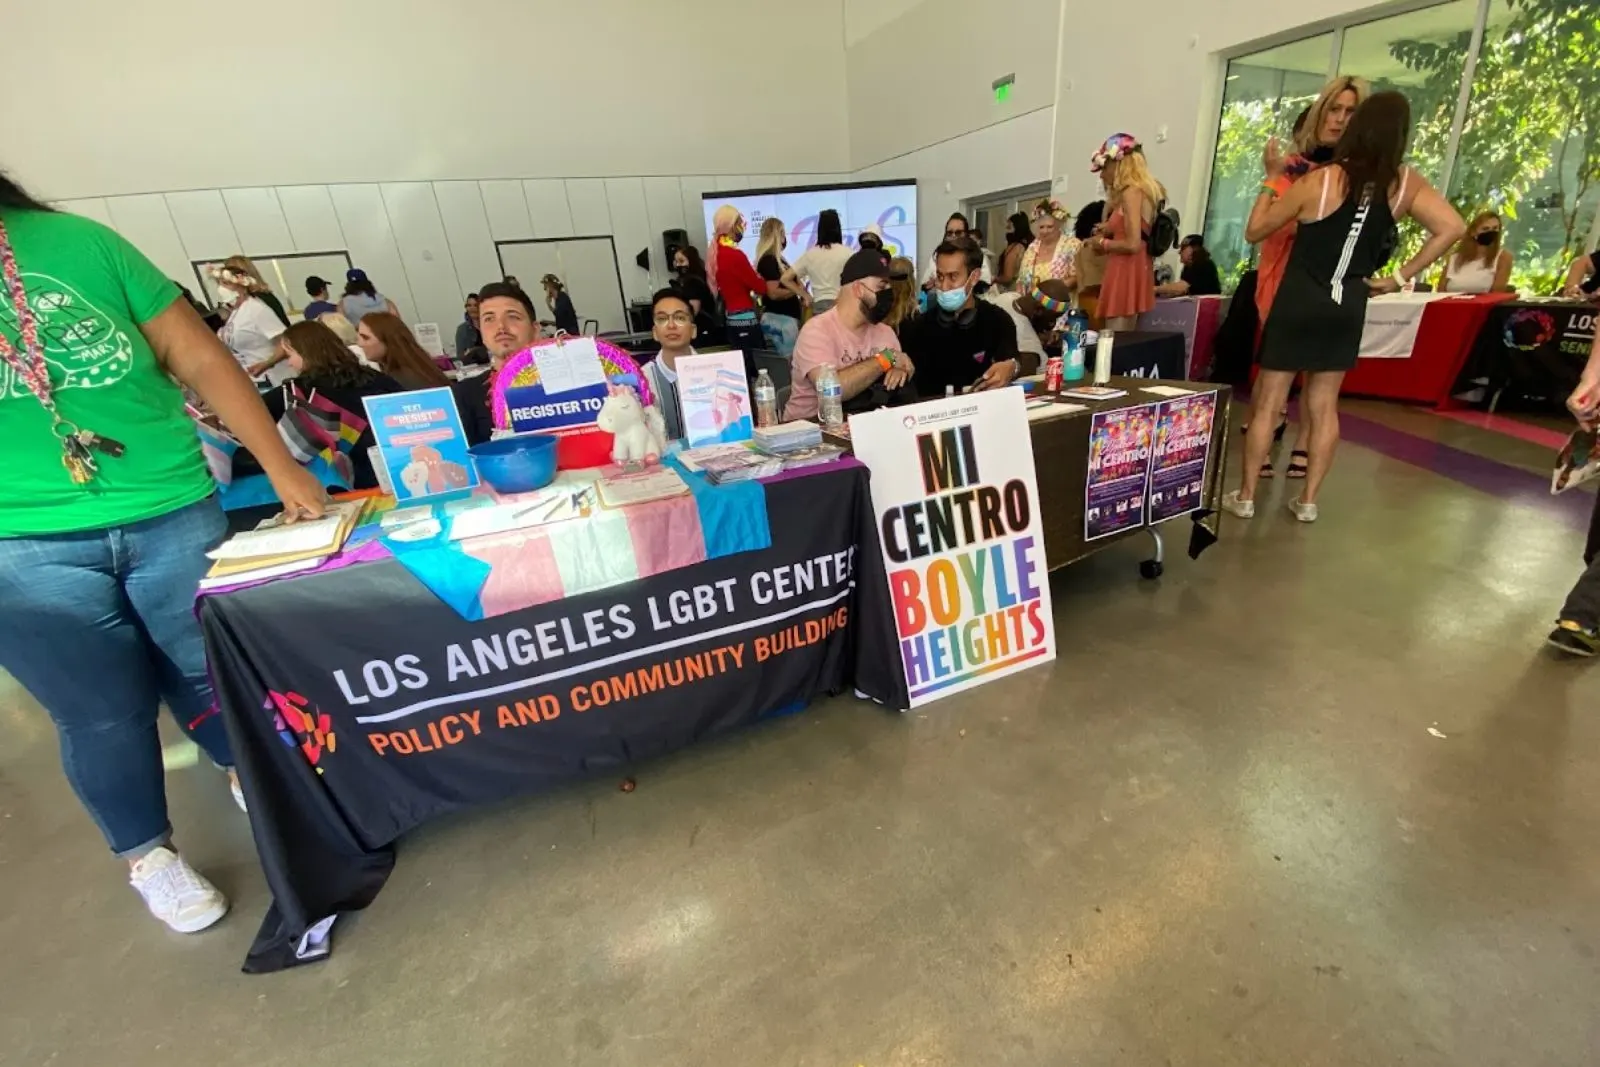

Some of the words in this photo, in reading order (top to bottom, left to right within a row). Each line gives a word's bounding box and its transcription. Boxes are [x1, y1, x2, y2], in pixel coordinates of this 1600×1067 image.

[512, 401, 580, 421] REGISTER
[581, 398, 602, 412] TO
[928, 410, 948, 420] ANGELES
[960, 405, 979, 414] CENTER
[1166, 432, 1209, 453] CENTRO
[916, 424, 980, 496] MI
[1102, 448, 1149, 467] CENTRO
[881, 478, 1031, 563] CENTRO
[889, 536, 1041, 638] BOYLE
[333, 653, 430, 705] LOS
[446, 603, 637, 682] ANGELES
[647, 577, 737, 631] LGBT
[901, 600, 1045, 687] HEIGHTS
[368, 710, 481, 756] POLICY
[497, 694, 561, 728] AND
[569, 643, 745, 712] COMMUNITY
[754, 606, 848, 663] BUILDING
